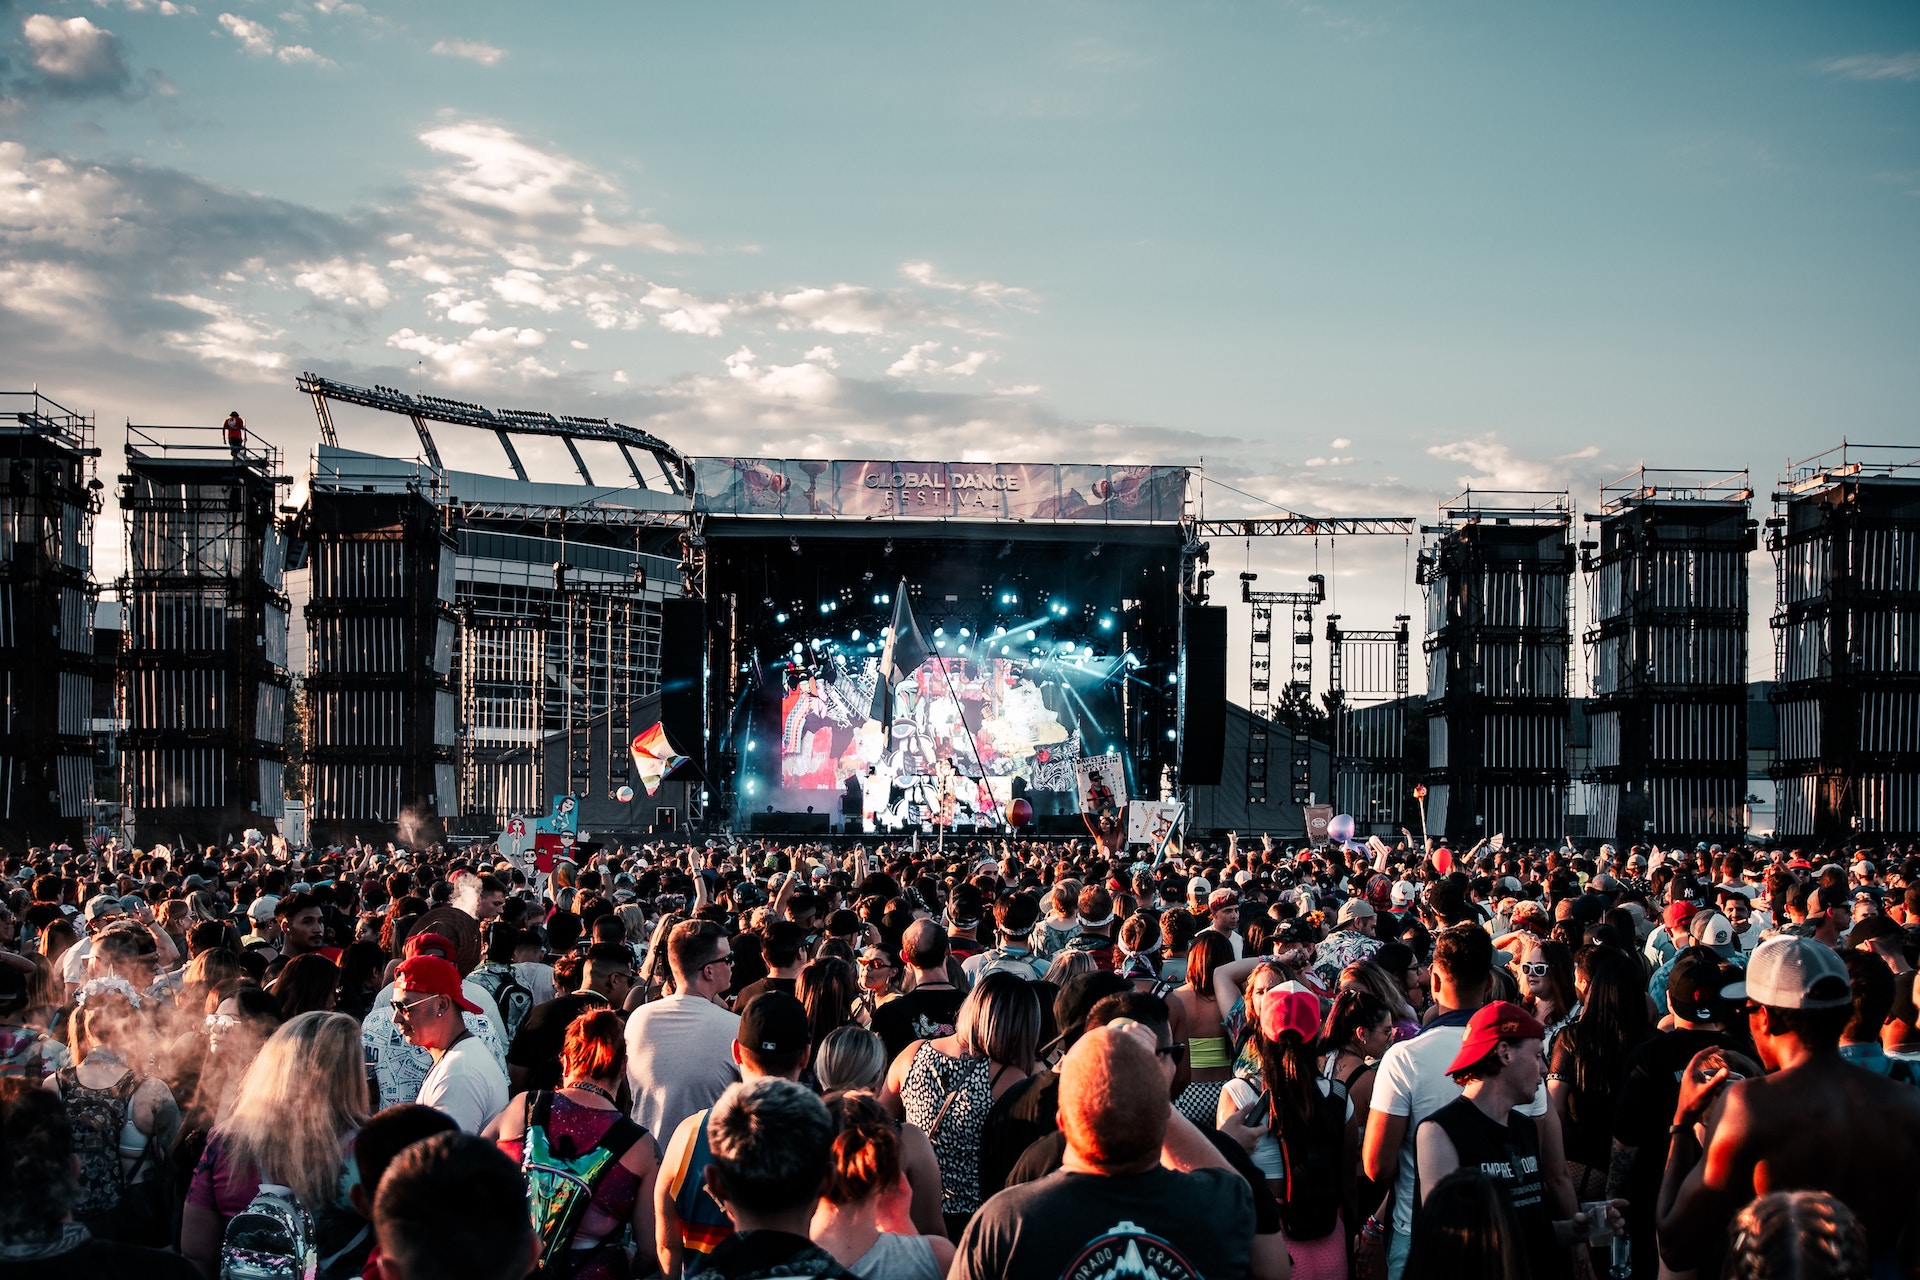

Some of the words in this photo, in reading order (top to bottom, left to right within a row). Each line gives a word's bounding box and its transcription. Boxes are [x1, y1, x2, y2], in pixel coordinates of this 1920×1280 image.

[865, 472, 945, 490] GLOBAL
[952, 473, 1020, 492] DANCE
[885, 491, 999, 507] FESTIVAL
